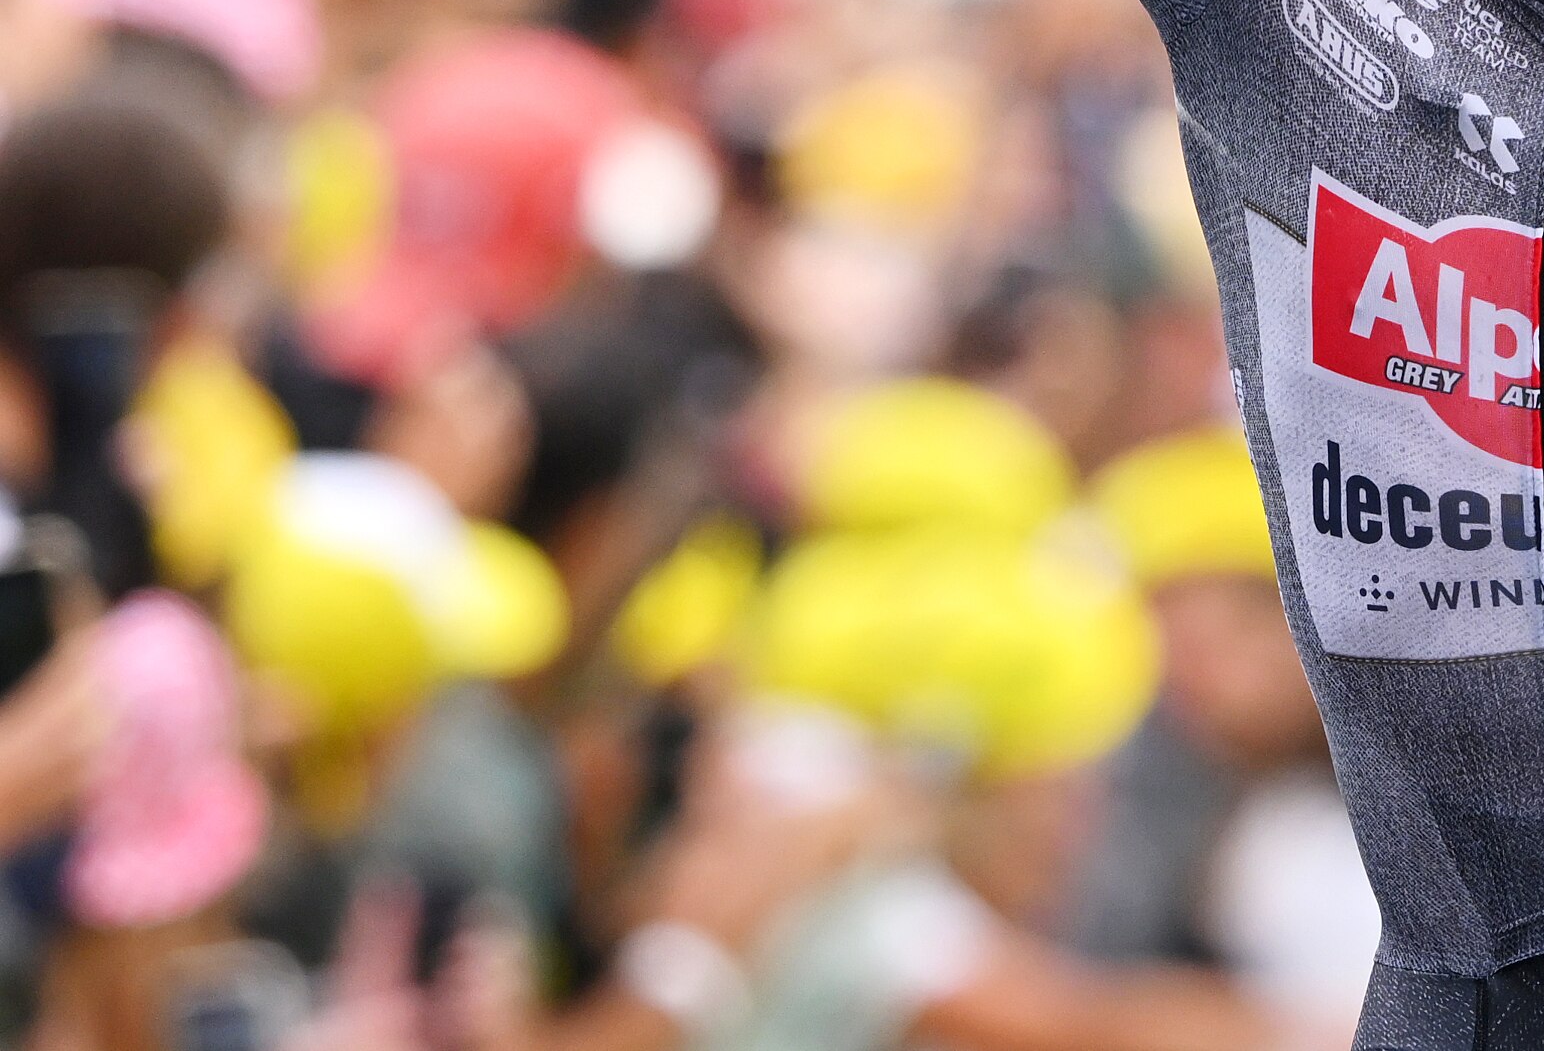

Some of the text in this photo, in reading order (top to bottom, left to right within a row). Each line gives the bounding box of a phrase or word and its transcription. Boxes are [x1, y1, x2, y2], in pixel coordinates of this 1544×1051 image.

[1454, 20, 1504, 72] TEAM
[1459, 8, 1528, 69] WORLD
[1386, 357, 1462, 396] GREY
